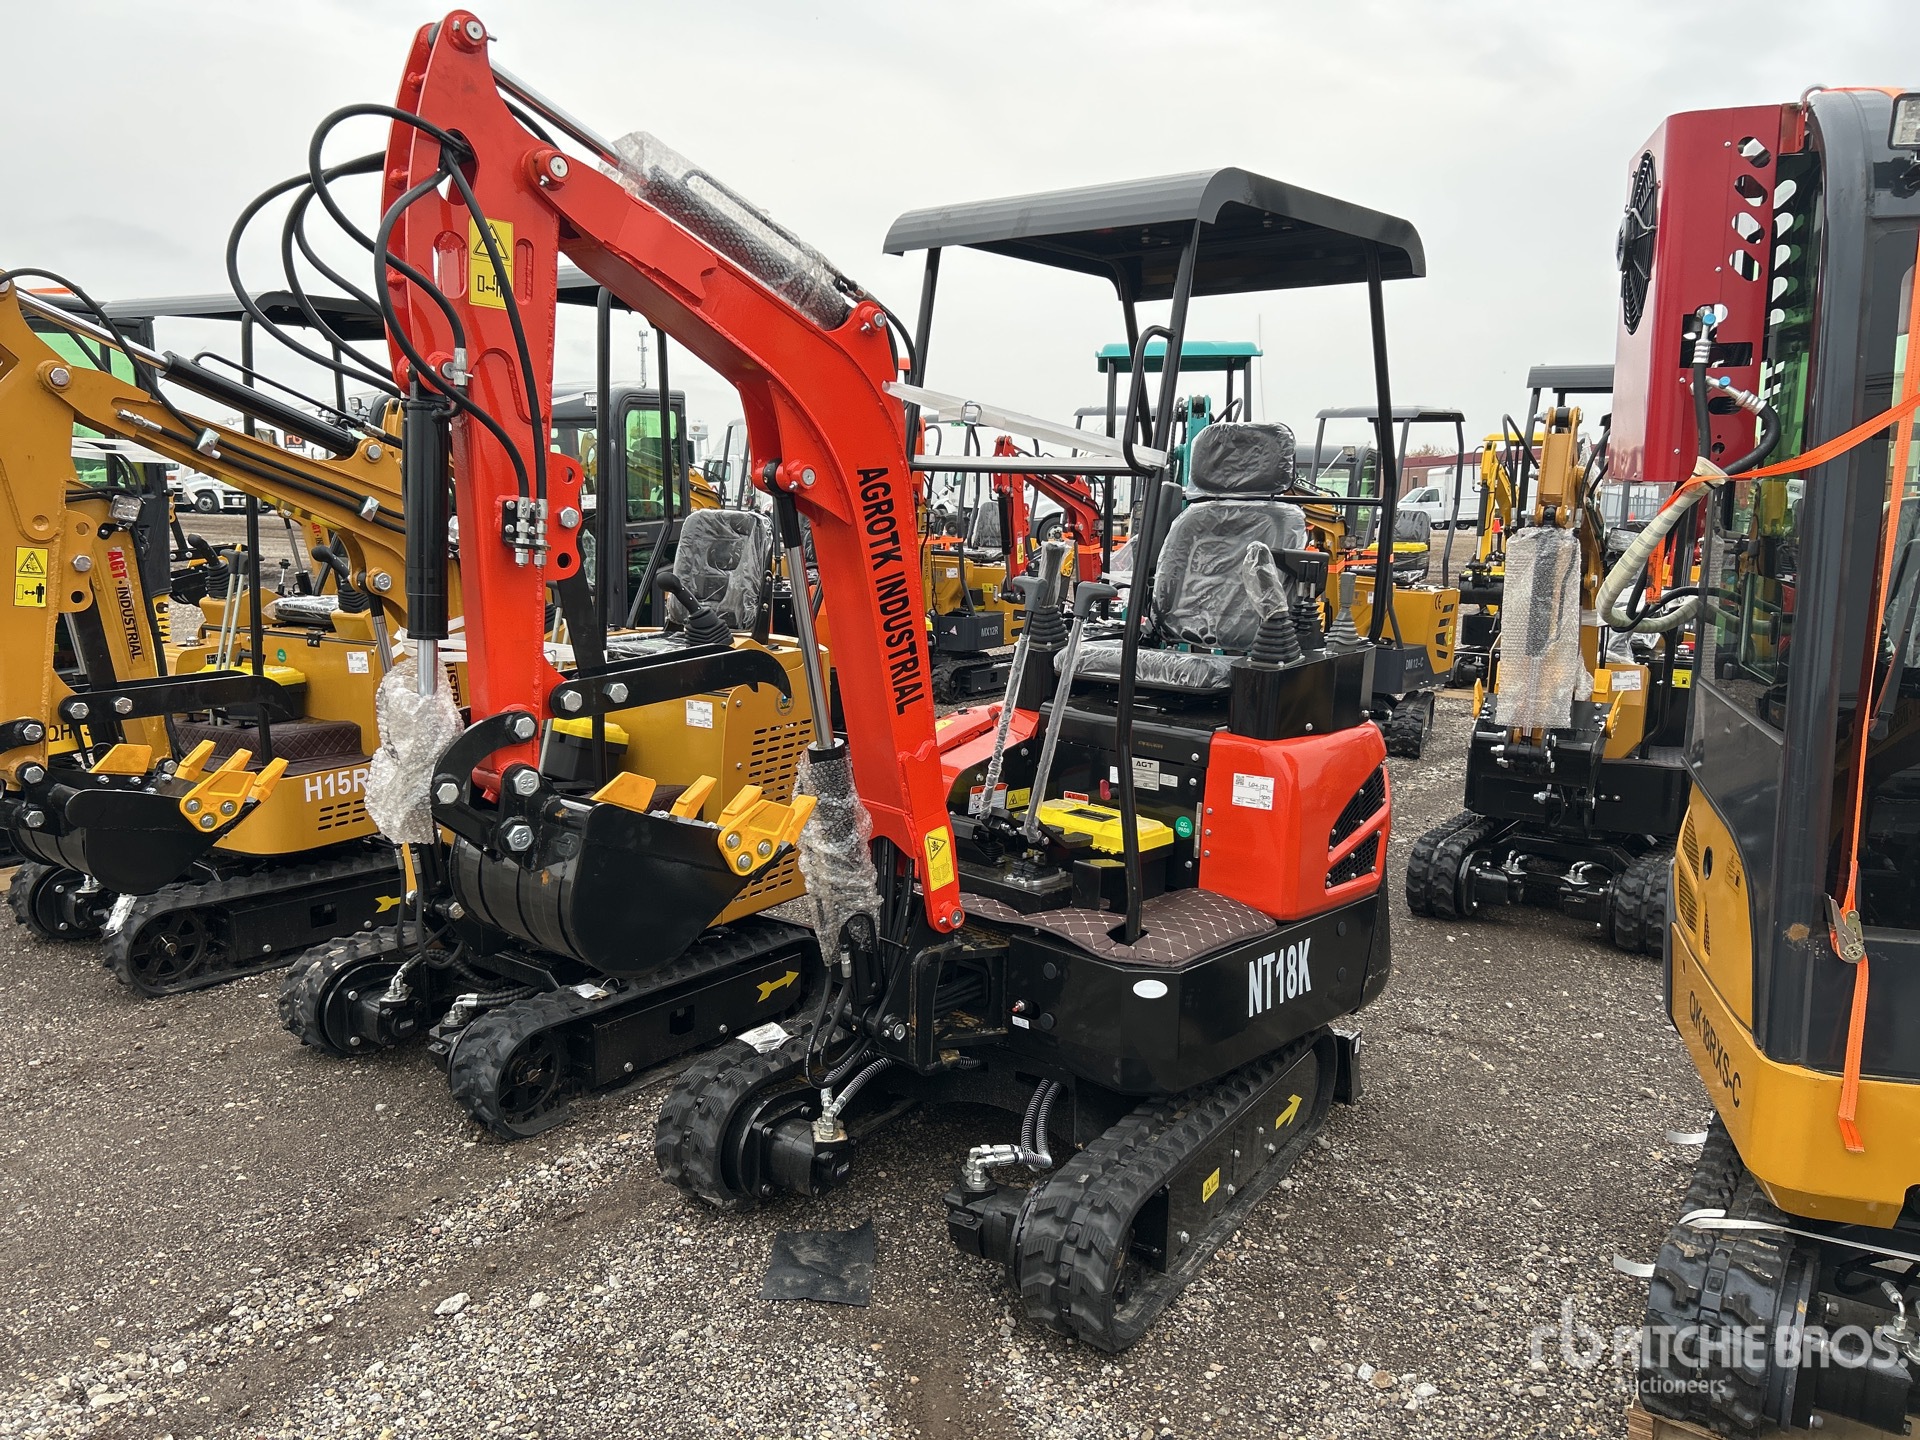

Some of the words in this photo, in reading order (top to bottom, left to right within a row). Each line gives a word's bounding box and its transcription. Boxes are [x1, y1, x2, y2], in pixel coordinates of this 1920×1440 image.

[857, 467, 903, 571] AGROTK
[107, 551, 128, 579] AGT
[117, 586, 142, 660] INDUSTRIAL
[875, 571, 925, 715] INDUSTRIAL
[1136, 760, 1154, 769] AGT
[1178, 826, 1190, 834] PASS
[1248, 937, 1312, 1018] NT18K
